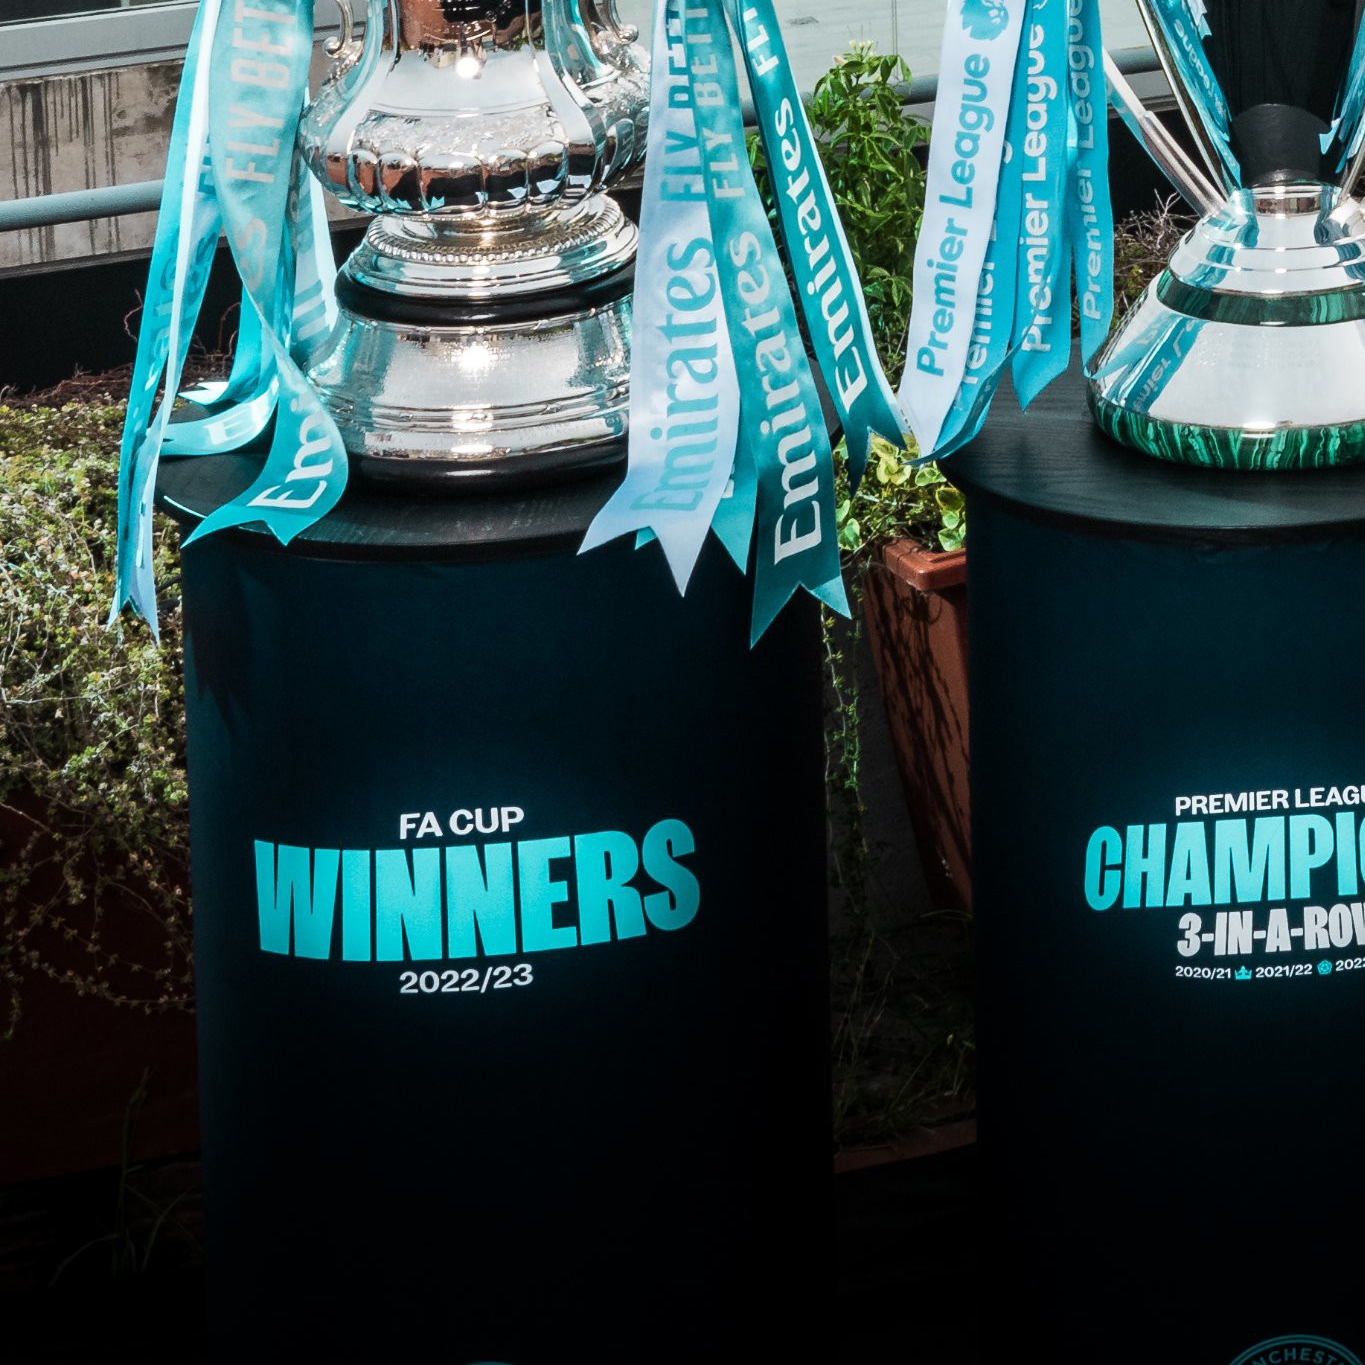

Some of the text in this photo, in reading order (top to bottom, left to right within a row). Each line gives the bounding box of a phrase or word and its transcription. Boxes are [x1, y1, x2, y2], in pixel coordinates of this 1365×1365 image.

[226, 121, 284, 186] FLY
[706, 129, 747, 199] FLY
[916, 52, 995, 377] Premier League
[1021, 23, 1058, 353] Premier League
[774, 96, 870, 415] Emirates
[1075, 168, 1104, 321] Premier
[629, 236, 720, 514] Emirates
[729, 229, 822, 566] Emirates
[399, 806, 525, 840] FA CUP
[1174, 788, 1290, 817] PREMIER
[253, 818, 701, 963] WINNERS
[399, 963, 534, 994] 2022/23
[1174, 965, 1232, 982] 2020/21
[1255, 963, 1313, 979] 2021/22
